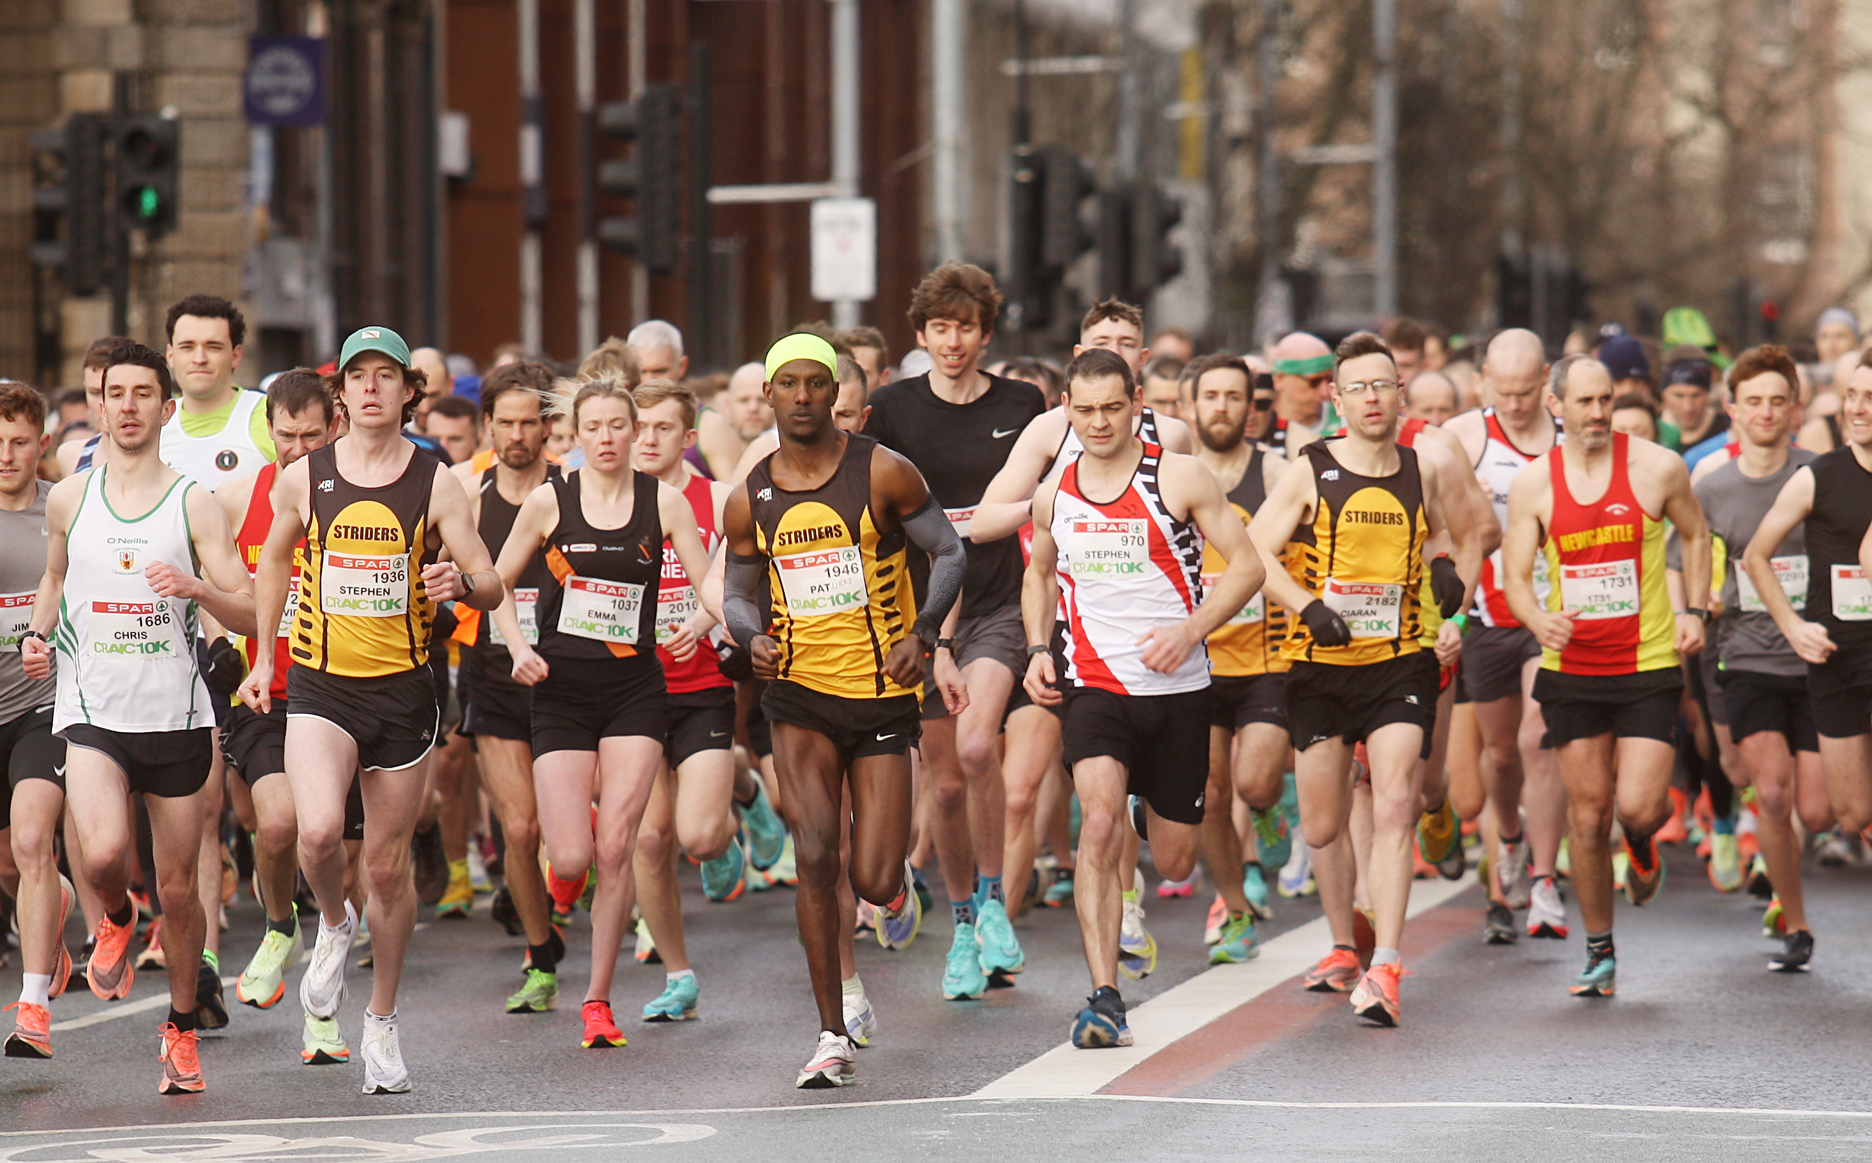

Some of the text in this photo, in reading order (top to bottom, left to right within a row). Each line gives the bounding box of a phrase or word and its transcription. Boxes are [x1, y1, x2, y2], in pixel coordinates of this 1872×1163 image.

[946, 512, 973, 520] PA
[1345, 511, 1403, 525] STRIDERS
[333, 524, 399, 542] STRIDERS
[1086, 523, 1128, 532] SPAR
[778, 524, 843, 546] STRIDERS
[1120, 535, 1145, 547] 970
[1559, 524, 1634, 552] NEWCASTLE
[793, 553, 840, 567] SPAR
[1084, 550, 1131, 559] STEPHEN
[342, 559, 390, 569] SPAR
[824, 562, 859, 578] 1946
[1072, 562, 1145, 574] CRAIC10K
[372, 569, 405, 584] 1936
[1575, 566, 1617, 577] SPAR
[810, 583, 831, 594] PAT
[1600, 576, 1632, 589] 1731
[339, 585, 391, 596] STEPHEN
[585, 582, 627, 596] SPAR
[1340, 586, 1383, 595] SPAR
[4, 595, 36, 607] SPA
[325, 596, 404, 611] CRAIC10K
[790, 590, 862, 610] CRAIC10K
[1365, 597, 1397, 606] 2182
[1587, 594, 1611, 603] 1731
[107, 603, 153, 612] SPAR
[611, 599, 639, 611] 1037
[587, 609, 617, 622] EMMA
[1340, 609, 1377, 618] CIARAN
[136, 613, 171, 627] 1686
[563, 616, 634, 638] CRAIC10K
[114, 631, 148, 640] CHRIS
[94, 640, 171, 654] CRAIC10K
